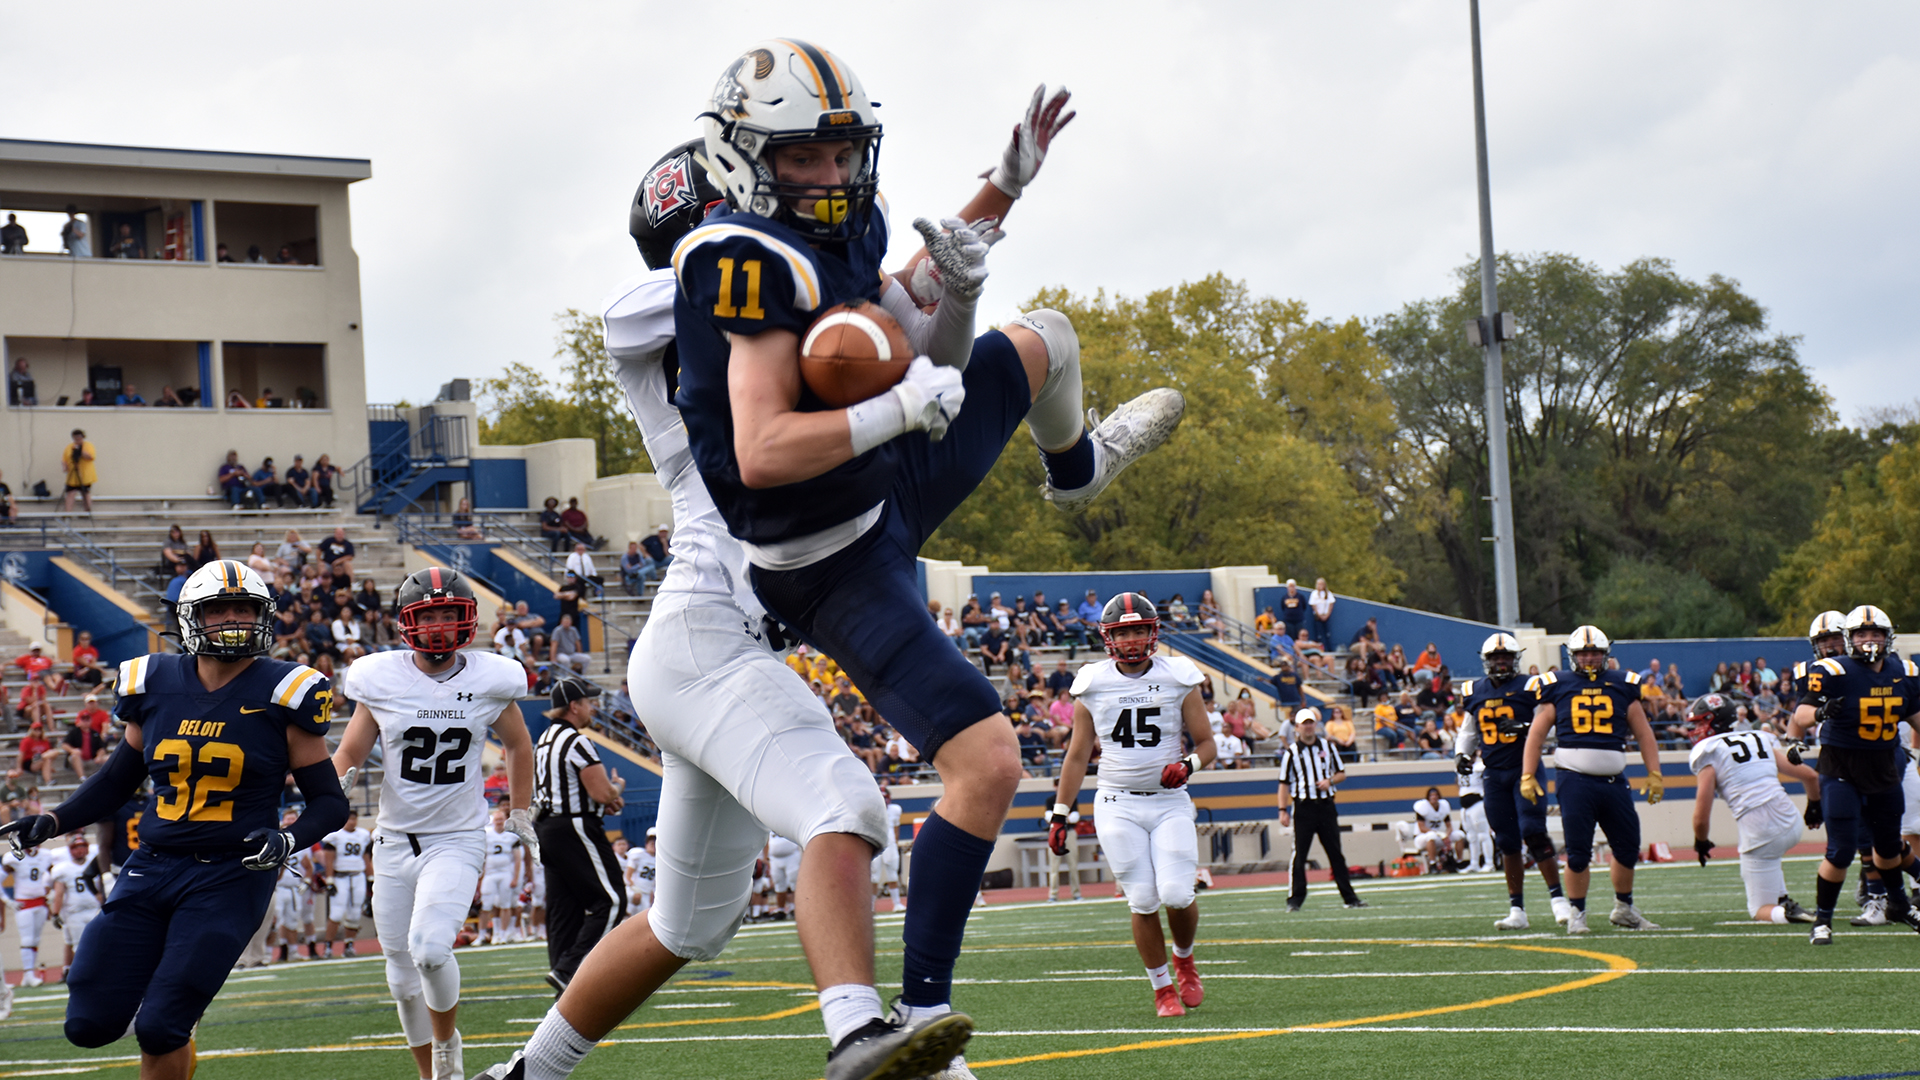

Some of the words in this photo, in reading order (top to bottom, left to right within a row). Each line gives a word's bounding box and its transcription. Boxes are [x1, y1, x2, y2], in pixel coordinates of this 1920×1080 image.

[829, 113, 853, 125] BUCS
[655, 172, 676, 200] G
[714, 257, 765, 320] 11
[1119, 696, 1153, 704] GRINNELL
[1871, 687, 1893, 696] BELOIT
[417, 710, 466, 719] GRINNELL
[1571, 695, 1614, 734] 62
[1858, 697, 1903, 741] 55
[177, 719, 226, 738] BELOIT
[1111, 707, 1161, 748] 45
[401, 726, 472, 784] 22
[153, 738, 245, 821] 32
[30, 867, 39, 881] 8
[75, 877, 85, 893] 6
